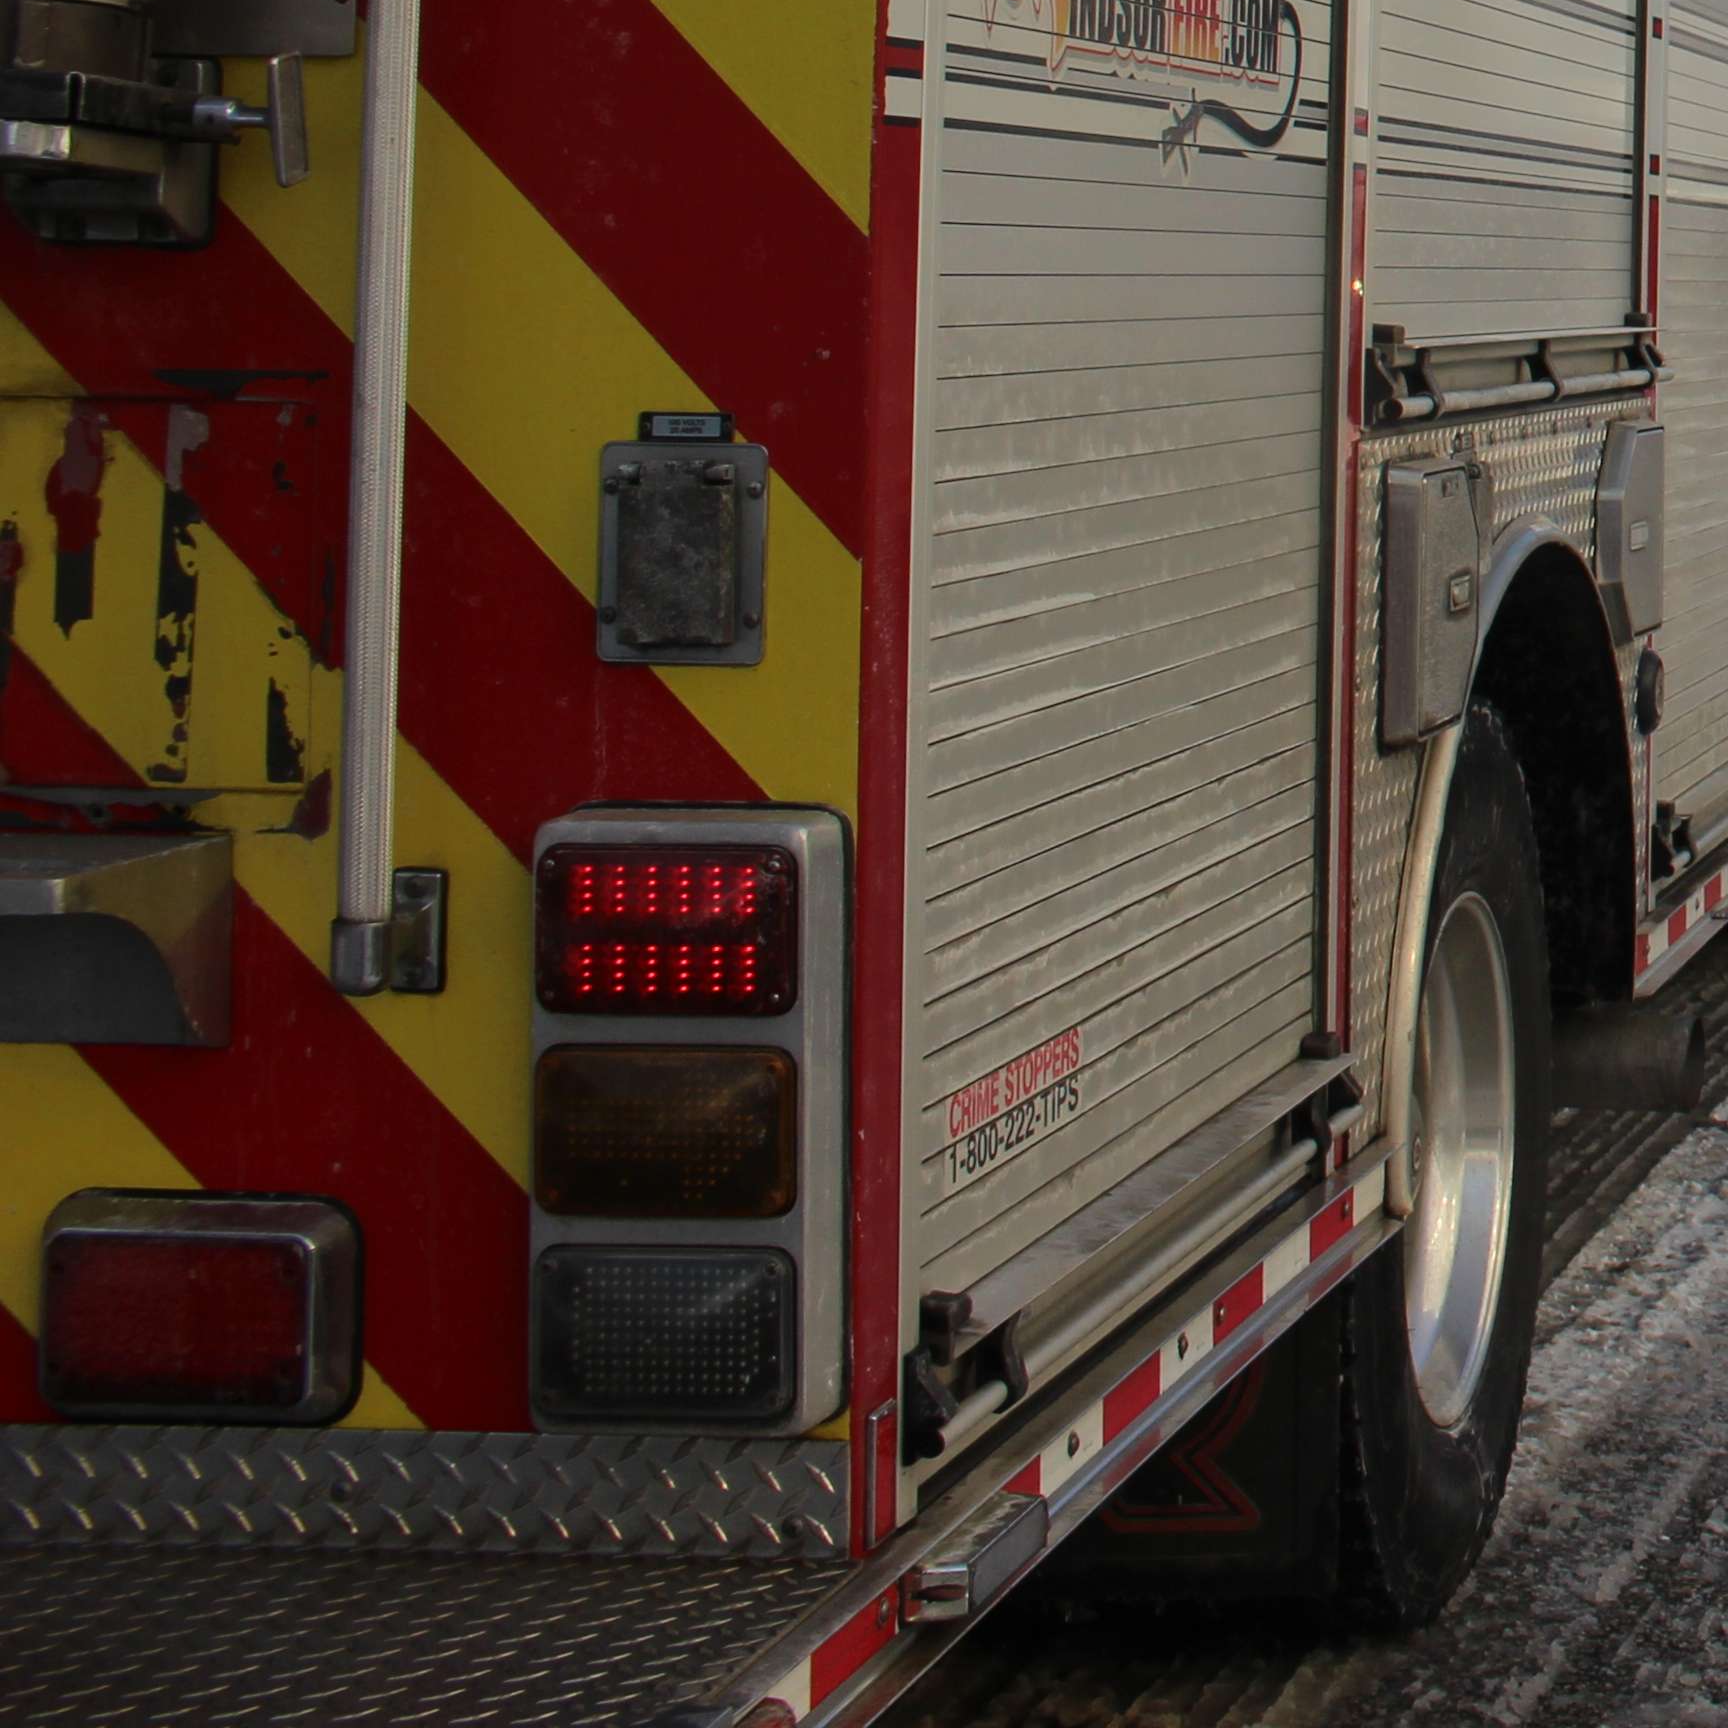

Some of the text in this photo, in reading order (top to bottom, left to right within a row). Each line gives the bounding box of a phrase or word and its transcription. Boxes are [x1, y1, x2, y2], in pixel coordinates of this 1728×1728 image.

[950, 1026, 1080, 1138] CRIME STOPPERS
[950, 1076, 1079, 1183] 1-800-222-TIPS
